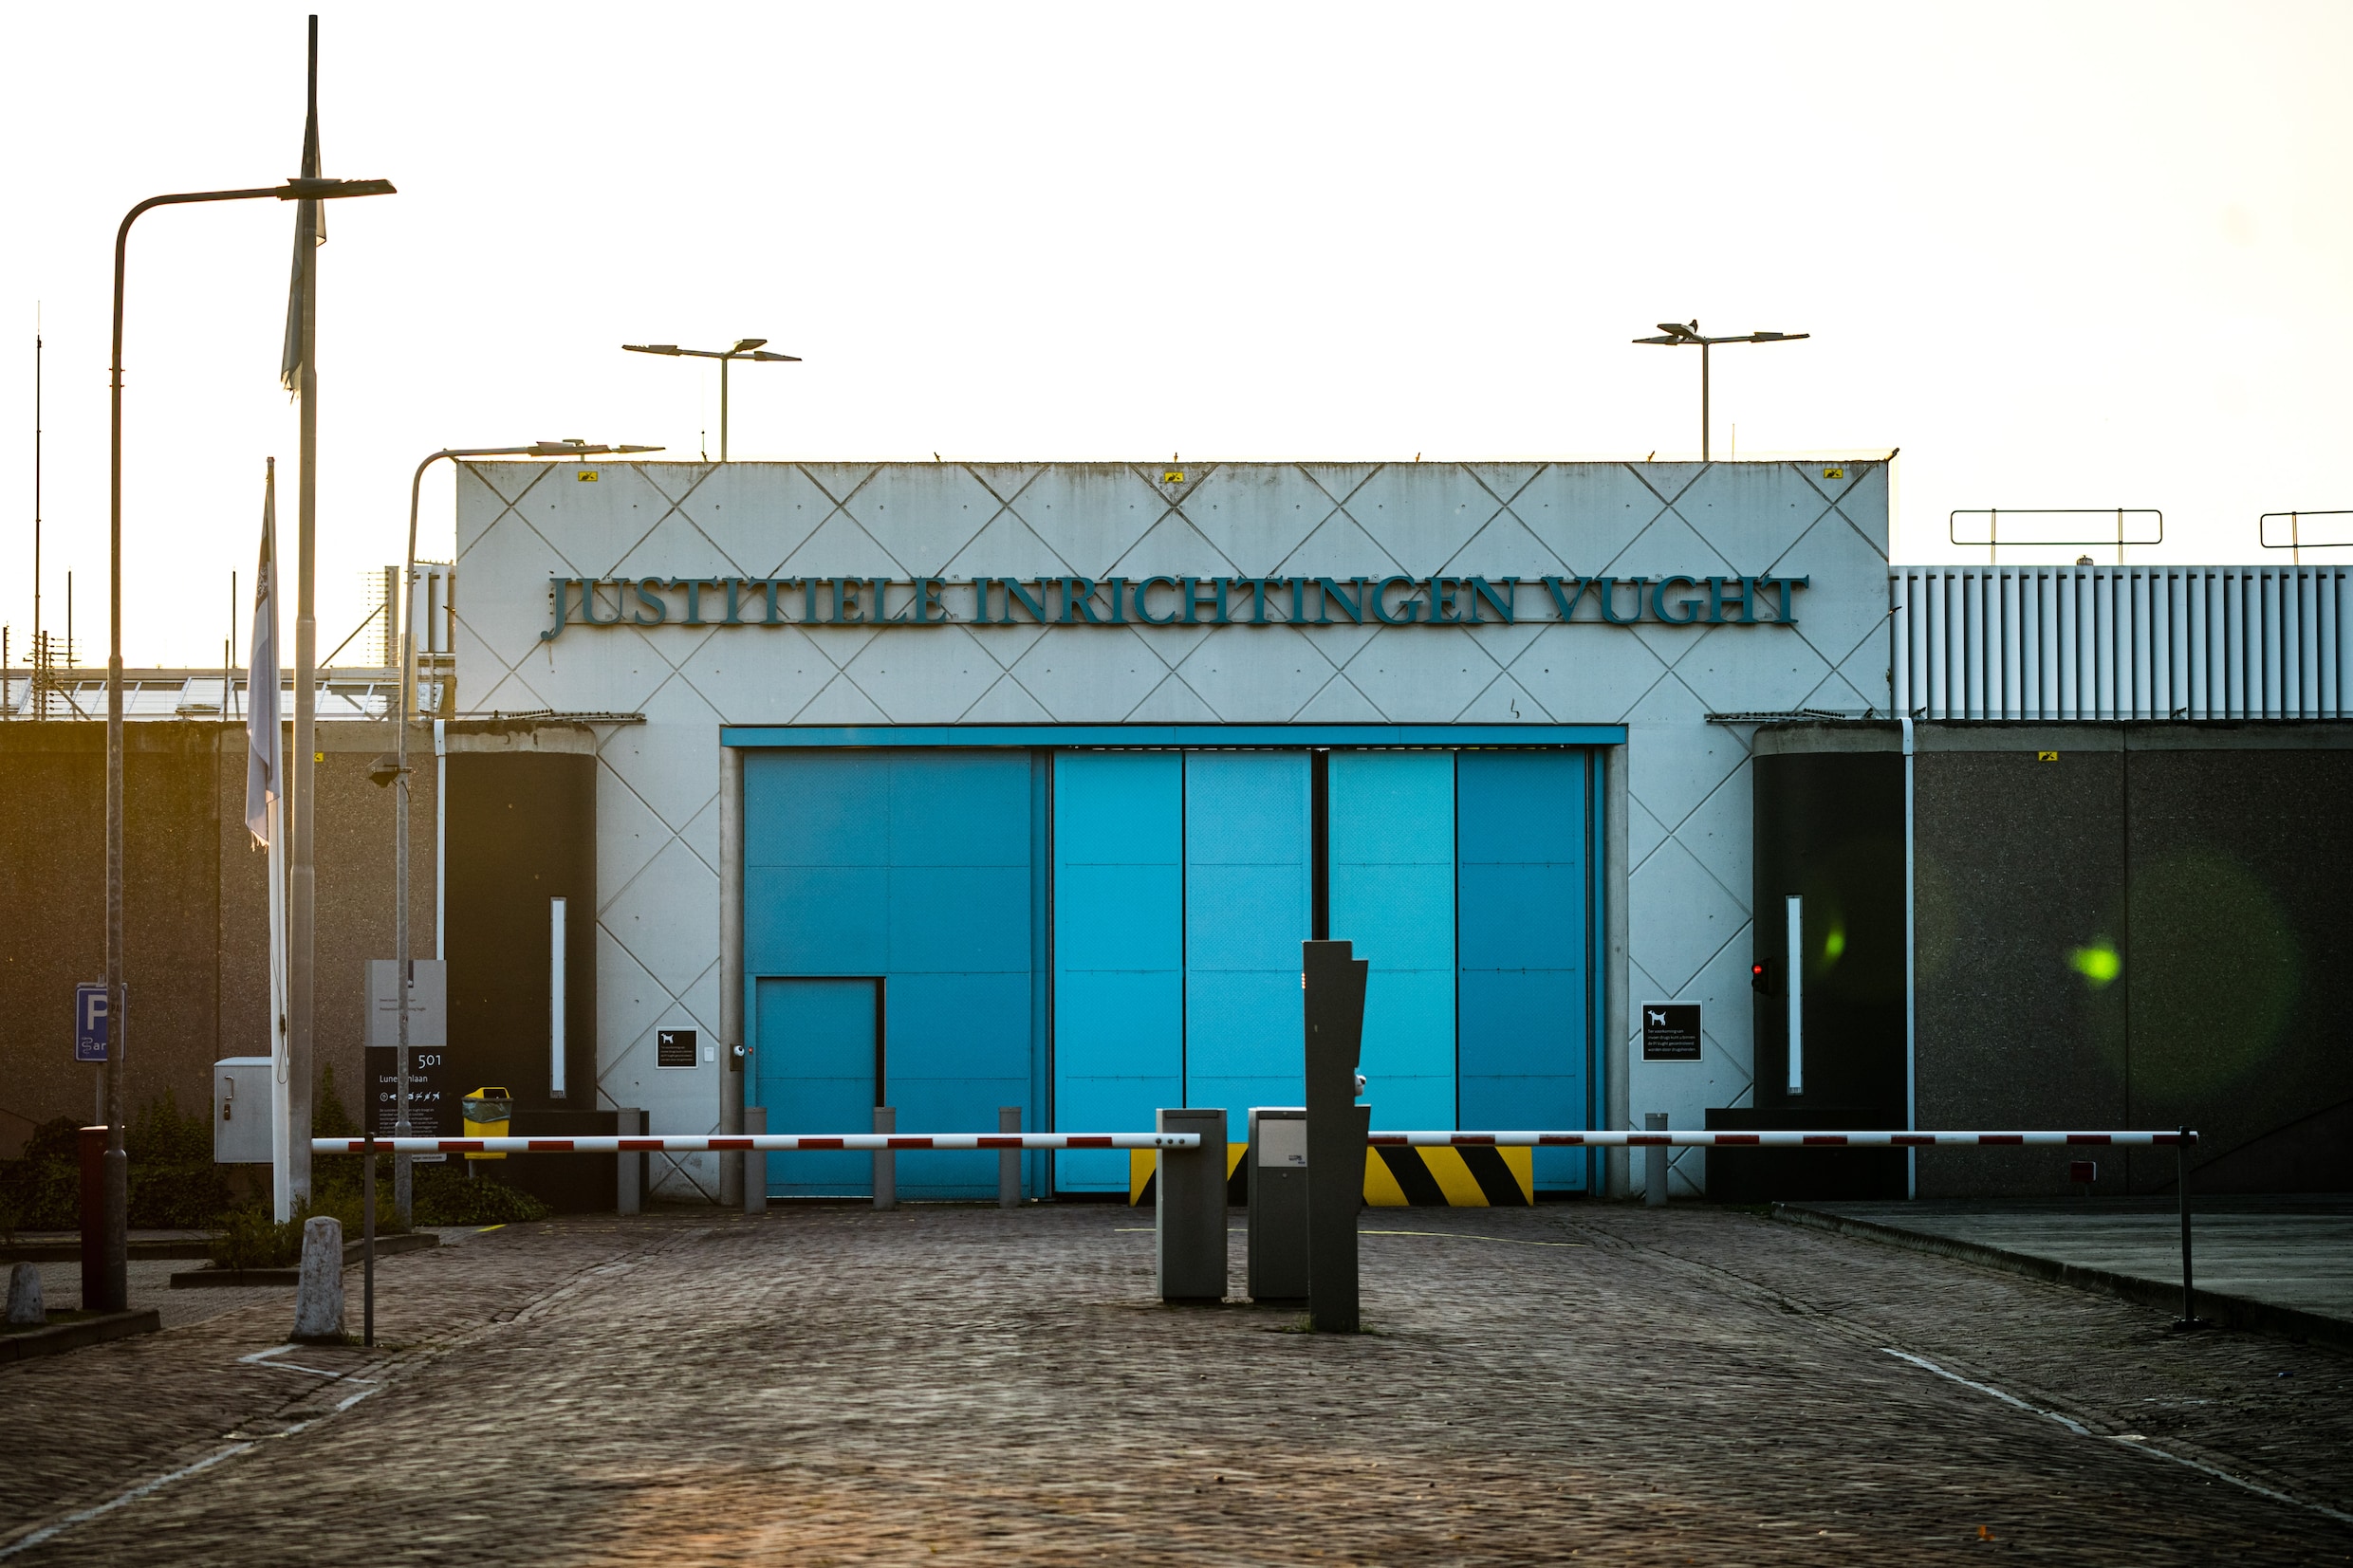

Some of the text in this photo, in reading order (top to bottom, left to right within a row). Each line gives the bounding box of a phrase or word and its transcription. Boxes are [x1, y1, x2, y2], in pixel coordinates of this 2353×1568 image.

[540, 574, 1809, 641] JUSTITIELE INRICHTINGEN VUGHT
[87, 994, 107, 1030] P
[418, 1054, 441, 1069] 501
[380, 1075, 428, 1083] Lunenlaan
